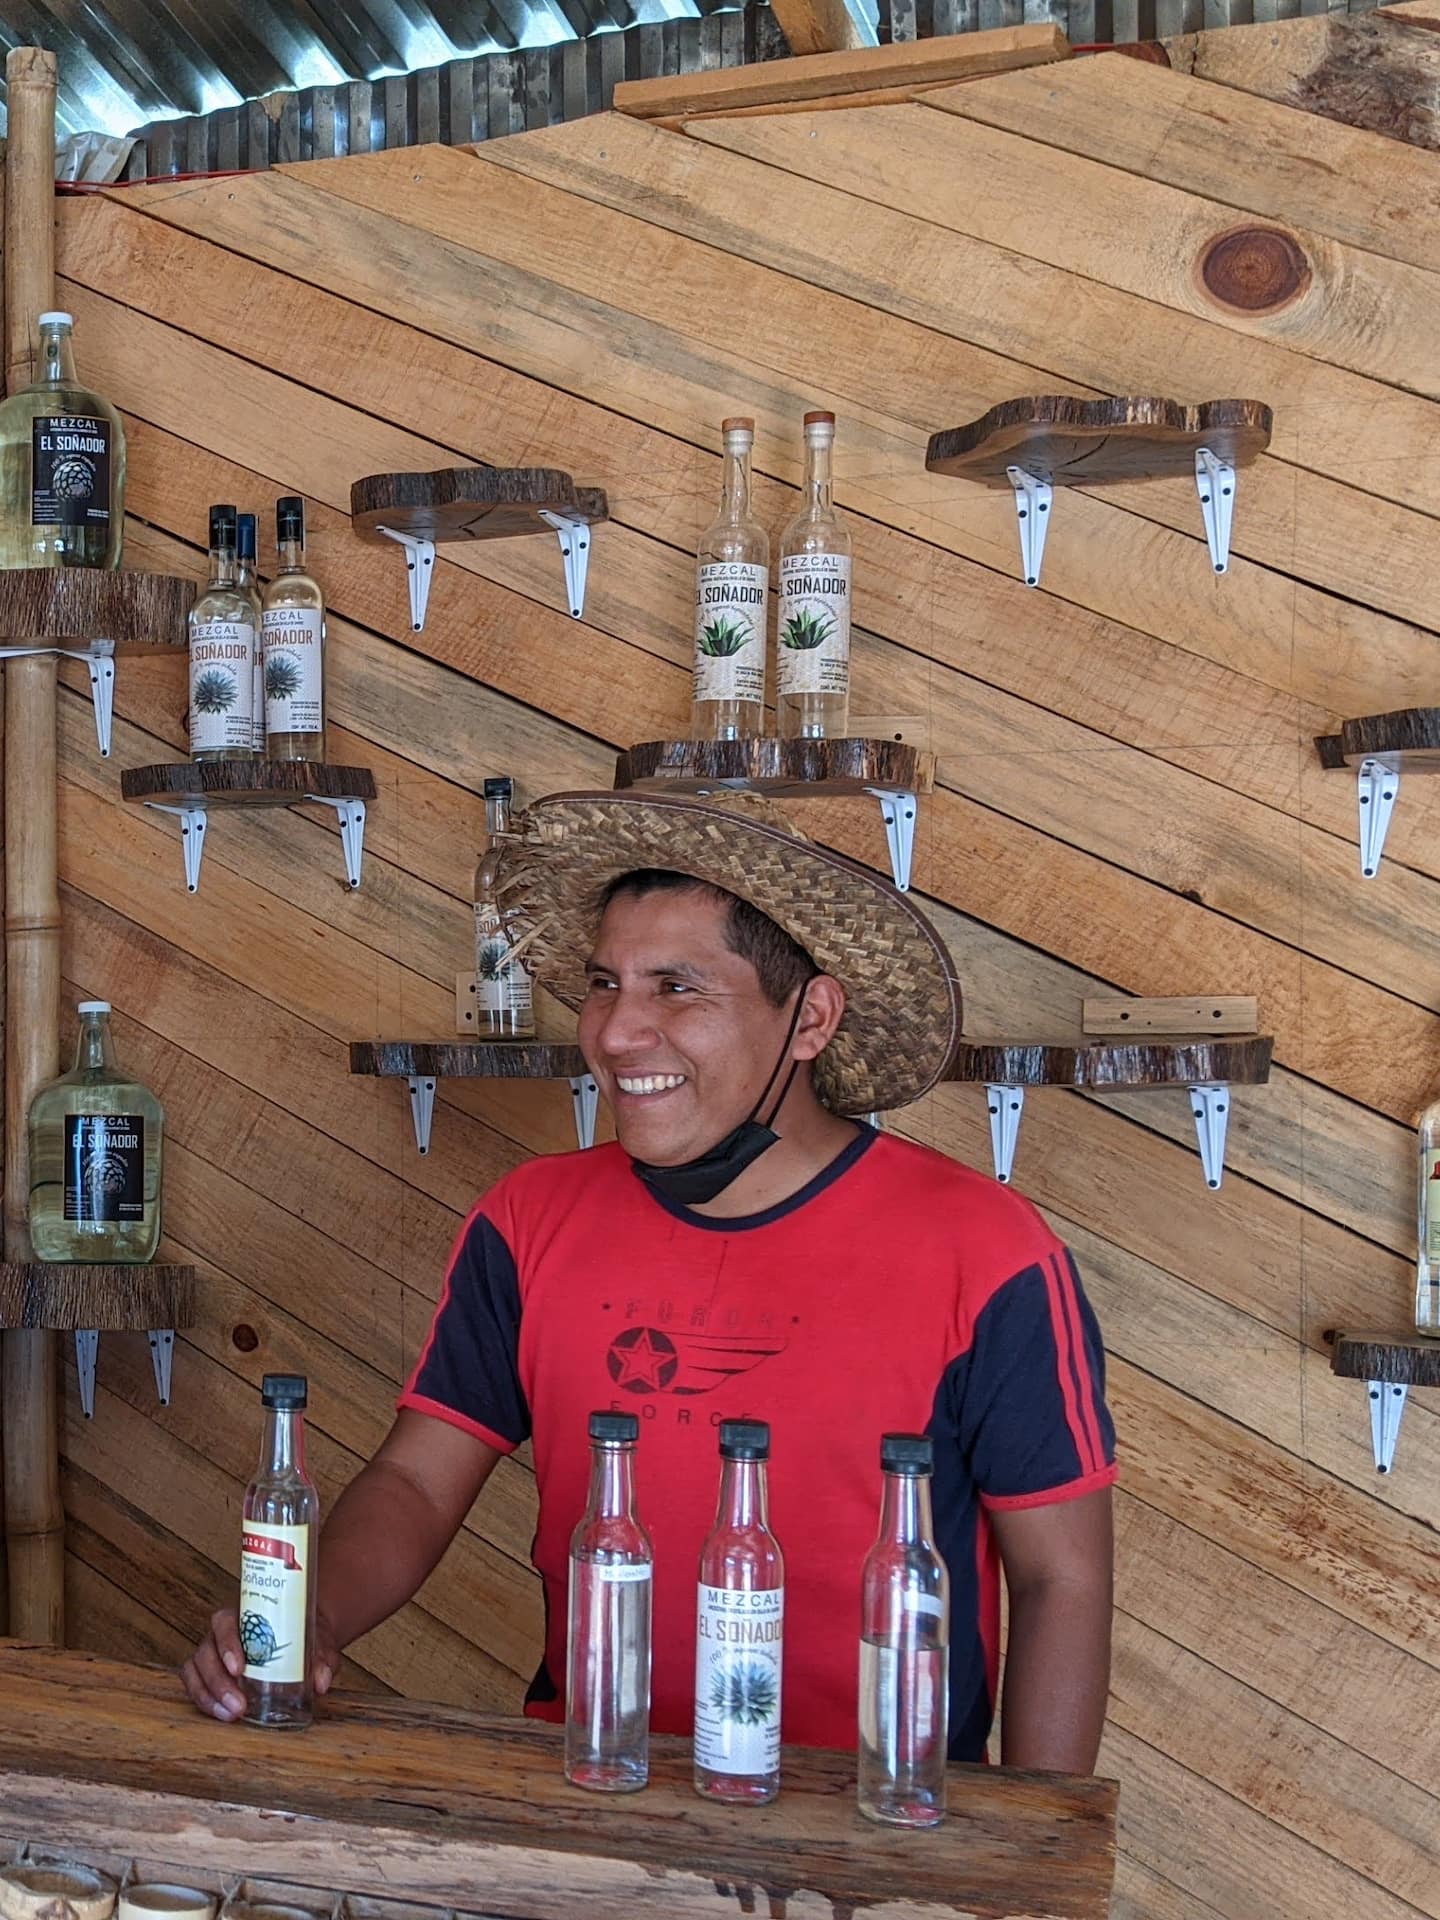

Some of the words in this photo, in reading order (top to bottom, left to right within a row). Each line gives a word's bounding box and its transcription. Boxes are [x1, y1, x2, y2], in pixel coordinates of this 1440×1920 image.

[50, 418, 98, 429] MEZCAL
[41, 436, 54, 450] EL
[57, 434, 105, 453] SOÑADOR
[701, 564, 756, 576] MEZCAL
[783, 556, 839, 568] MEZCAL
[787, 575, 846, 596] SOÑADOR
[705, 583, 763, 605] SOÑADOR
[264, 611, 304, 623] EZCAL
[191, 625, 239, 637] MEZCAL
[196, 642, 247, 660] SOÑADOR
[82, 1117, 130, 1126] MEZCAL
[73, 1134, 84, 1148] EL
[88, 1132, 138, 1148] SOÑADOR
[708, 1590, 780, 1607] MEZCAL
[700, 1614, 711, 1638] EL
[717, 1618, 783, 1643] SOÑADO
